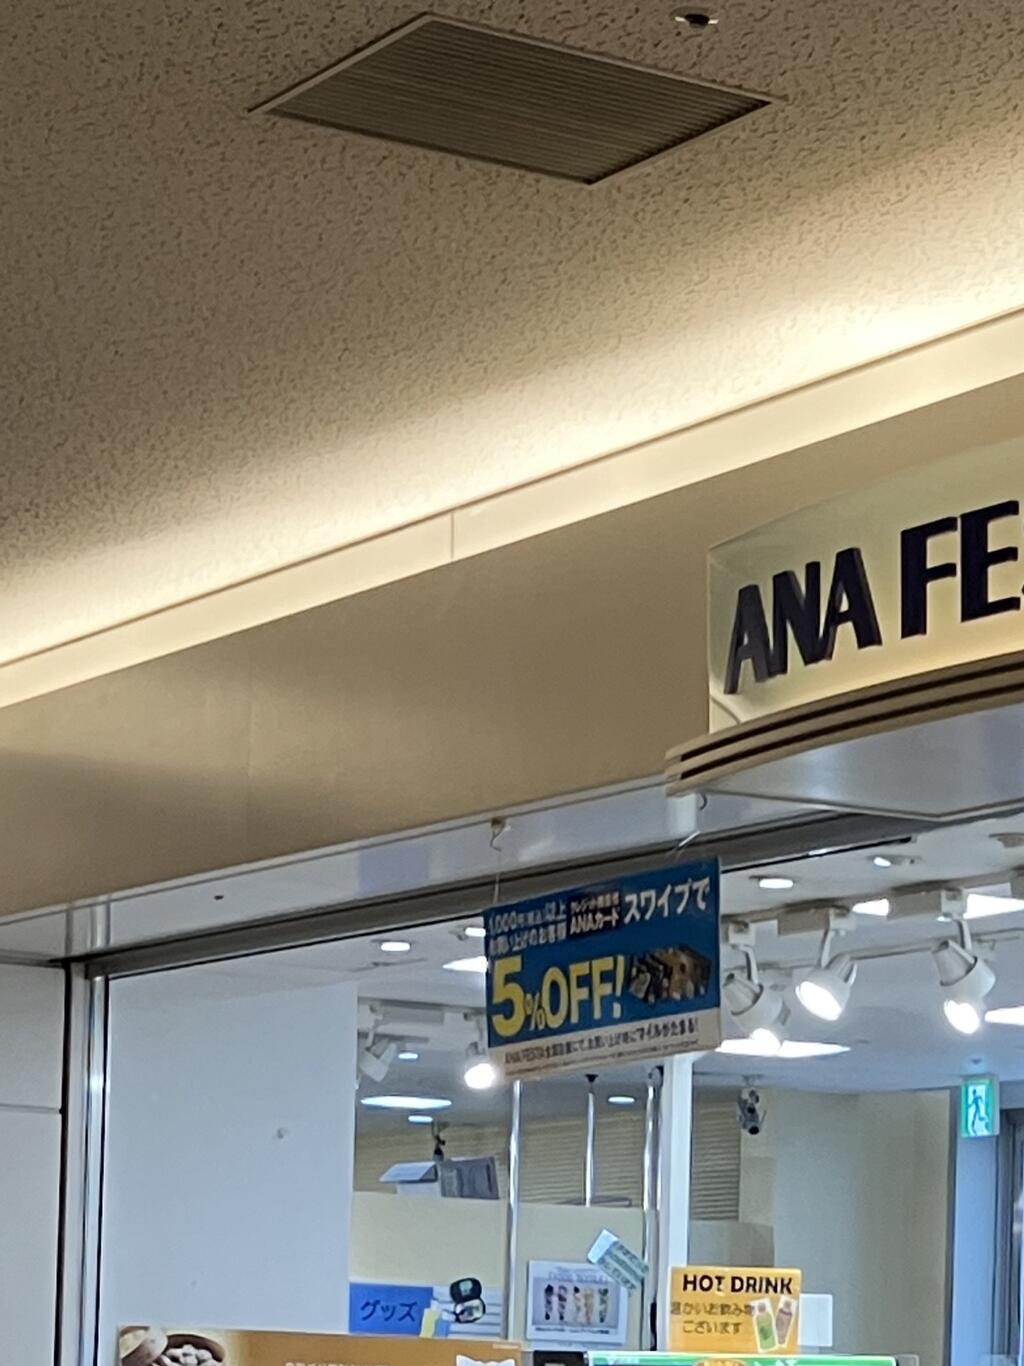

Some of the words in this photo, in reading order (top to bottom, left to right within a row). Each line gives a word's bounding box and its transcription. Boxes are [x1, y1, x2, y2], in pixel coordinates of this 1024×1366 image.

[724, 547, 883, 695] ANA
[570, 907, 620, 935] ANAカード
[624, 876, 710, 924] スワイプで
[682, 1274, 725, 1292] HOT
[731, 1276, 793, 1294] DRINK
[360, 1300, 418, 1322] グッズ
[682, 1320, 742, 1334] ございます
